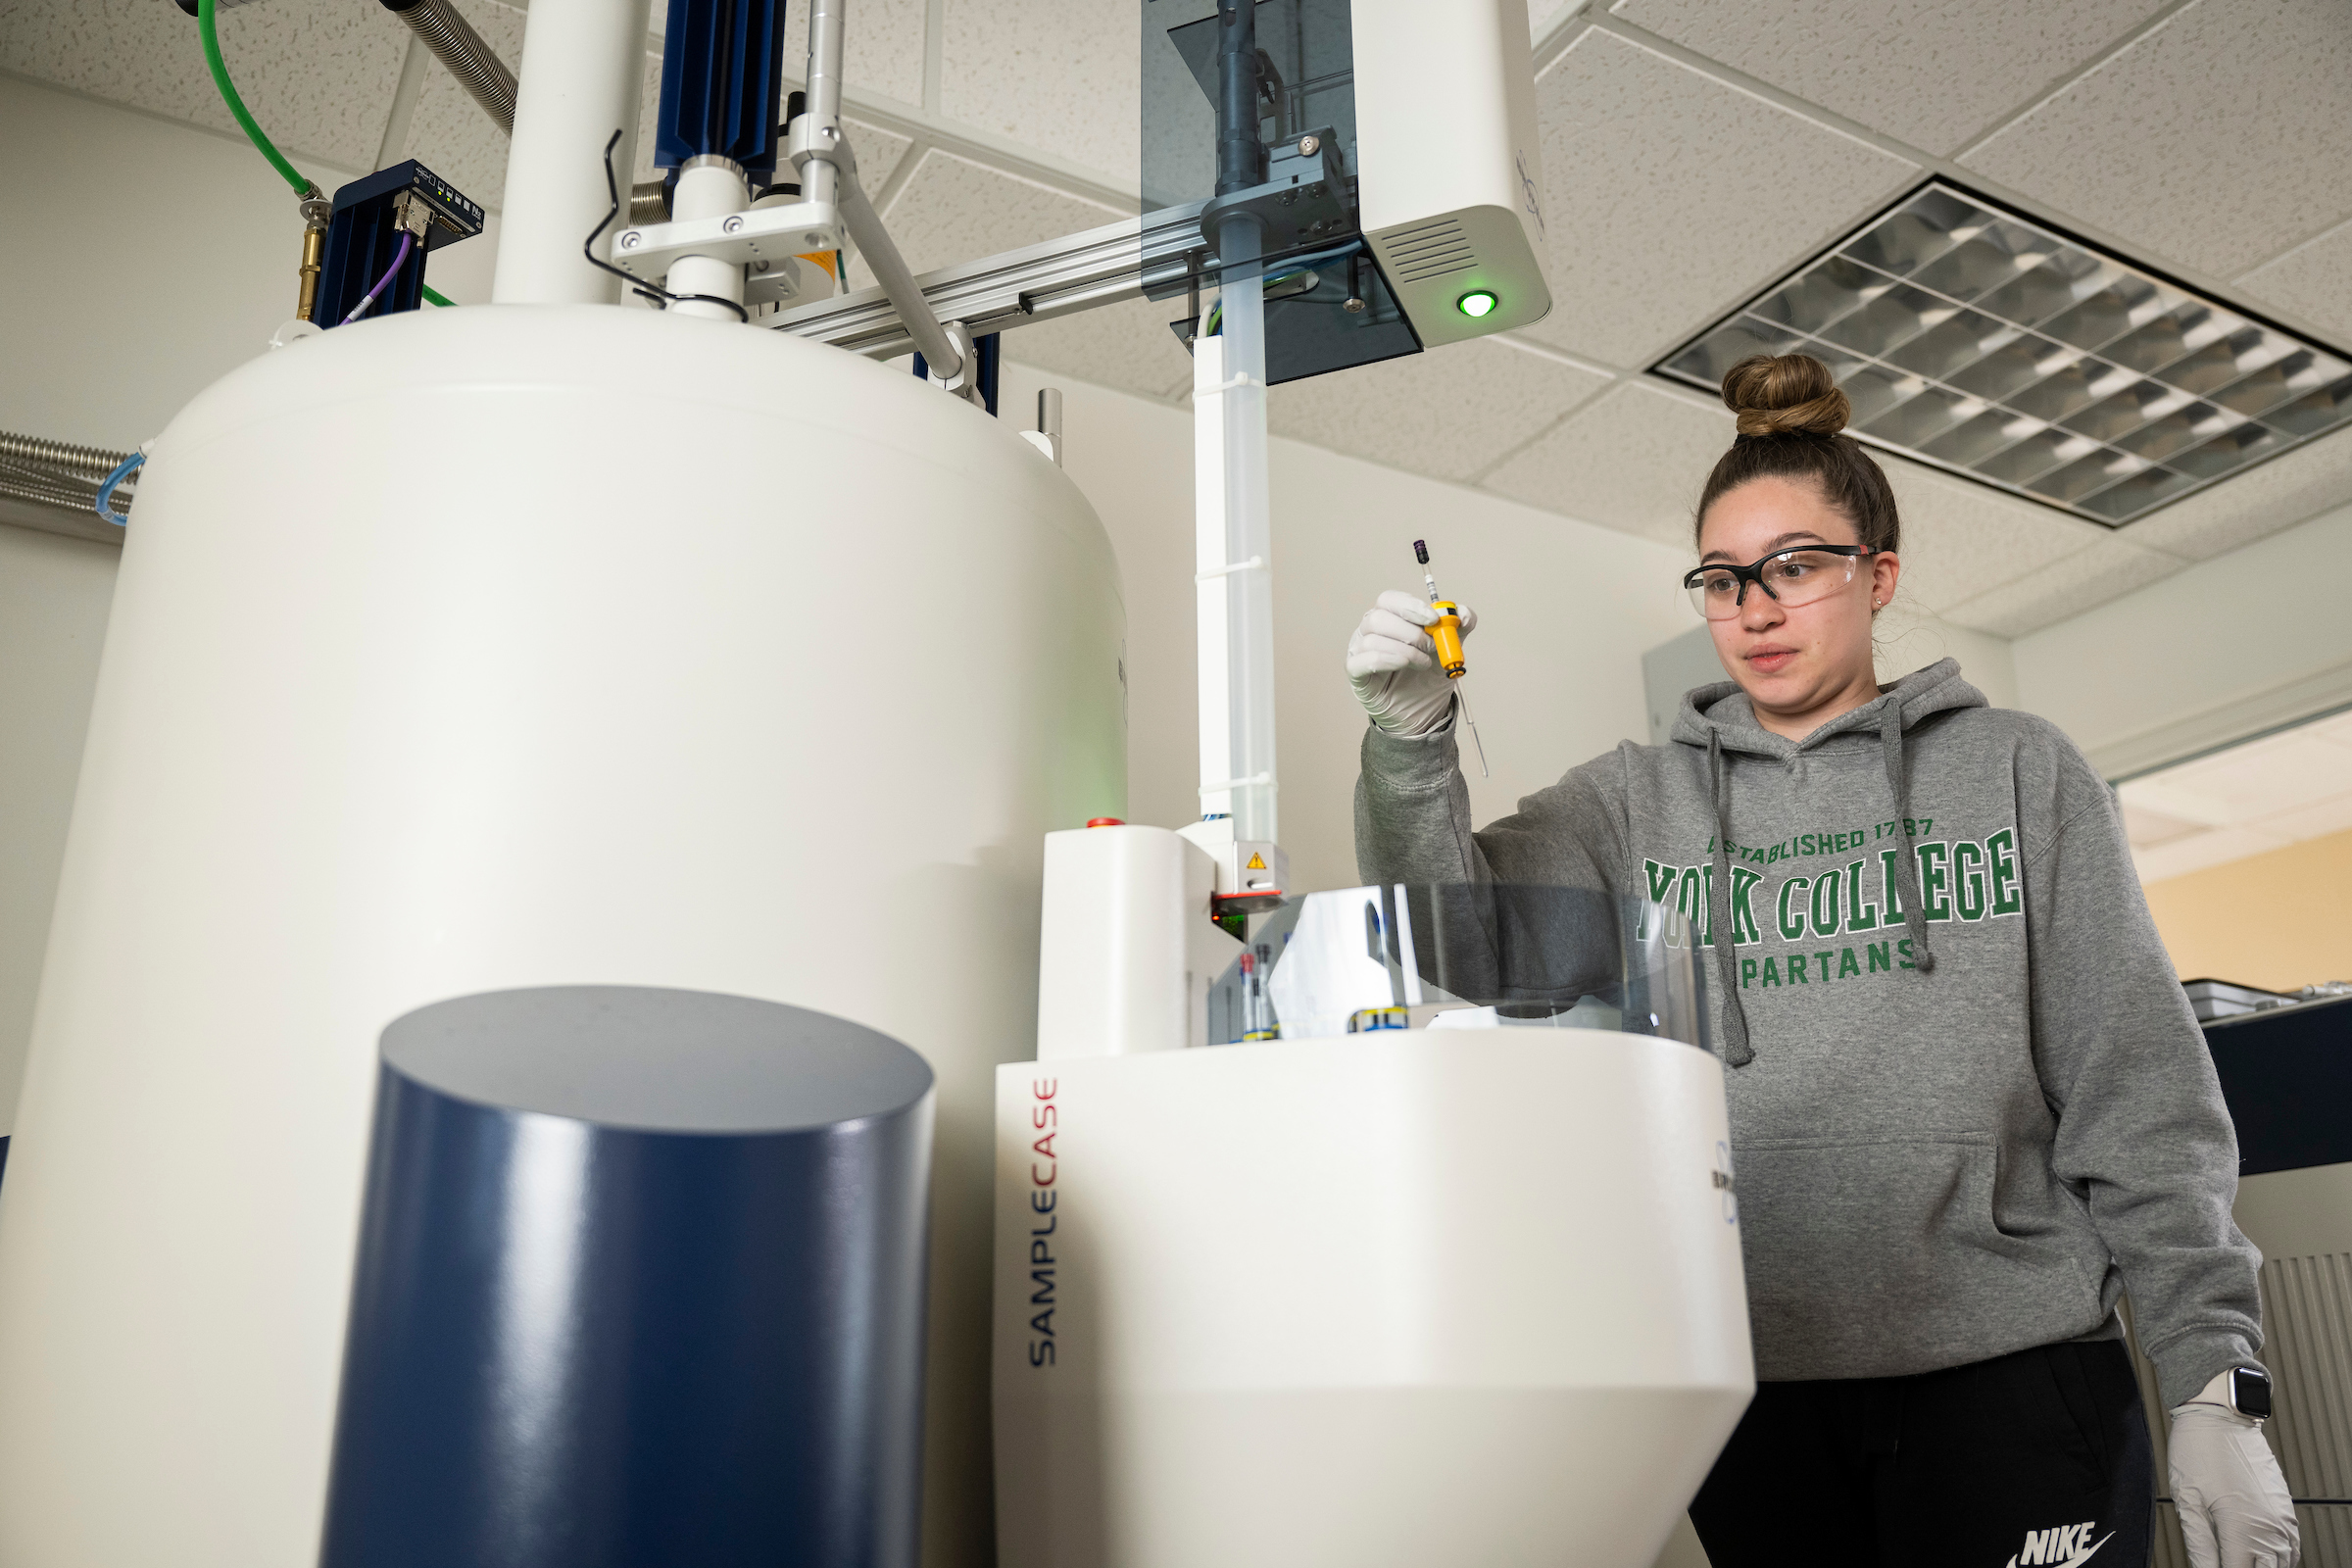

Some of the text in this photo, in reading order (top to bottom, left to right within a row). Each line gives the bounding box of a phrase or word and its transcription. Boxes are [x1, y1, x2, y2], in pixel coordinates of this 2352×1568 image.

[1874, 818, 1934, 840] 1787
[1776, 826, 2023, 942] COLLEGE
[1741, 938, 1917, 989] PARTANS
[1029, 1078, 1056, 1367] SAMPLECASE
[2020, 1521, 2095, 1565] NIKE
